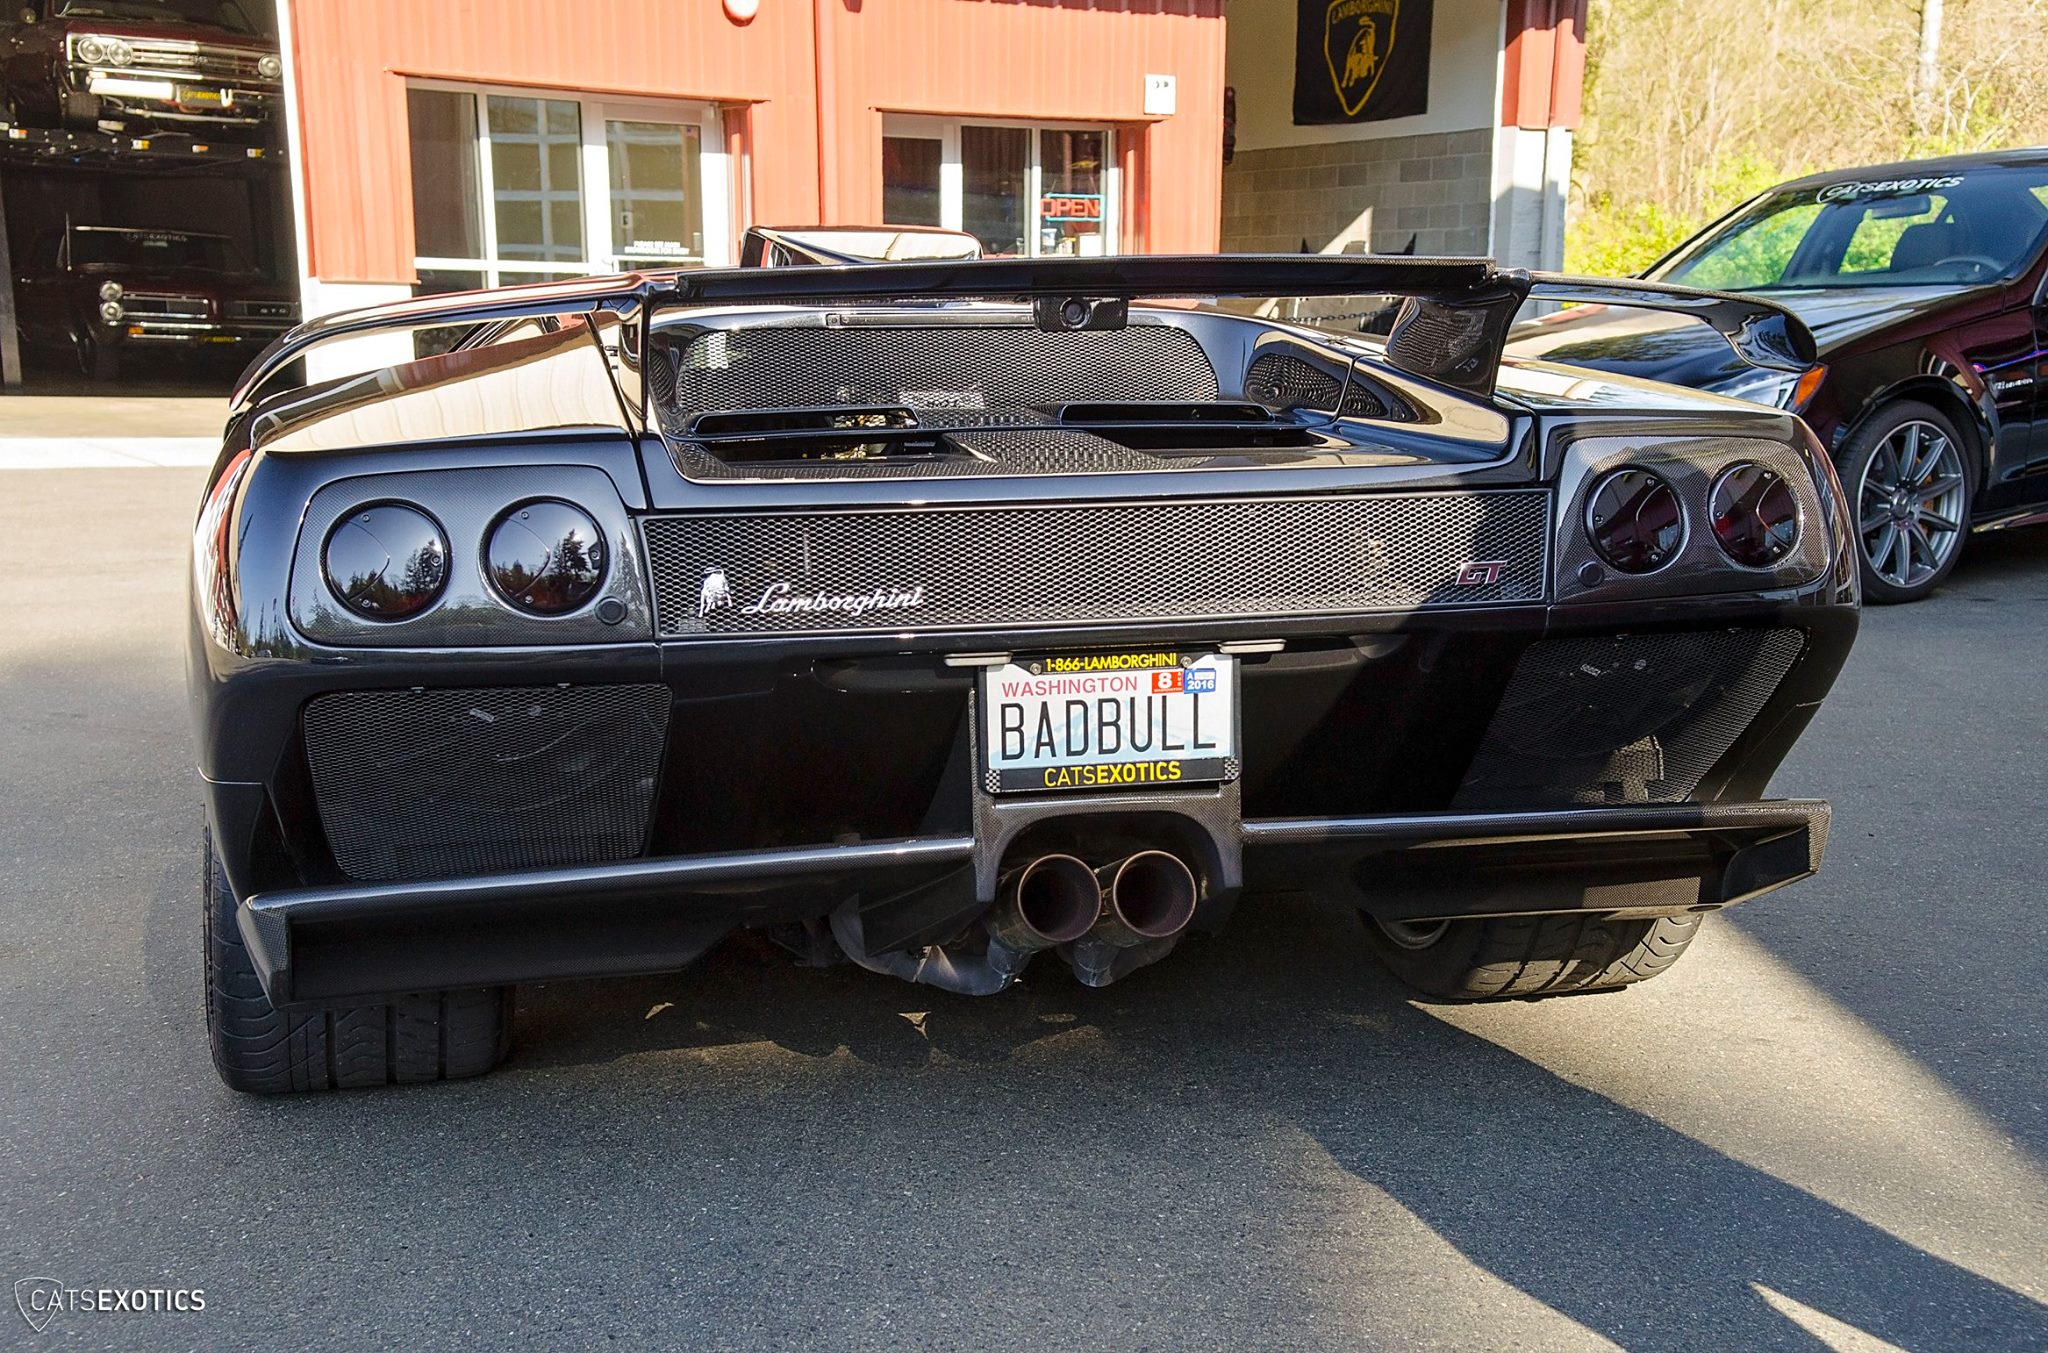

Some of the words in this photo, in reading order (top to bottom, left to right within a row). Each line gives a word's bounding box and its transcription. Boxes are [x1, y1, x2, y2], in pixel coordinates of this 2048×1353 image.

[1826, 176, 1965, 197] CATSEXOTICS
[1040, 198, 1100, 217] OPEN
[1455, 560, 1508, 585] GT
[741, 582, 925, 617] Lamborghini
[1046, 653, 1177, 672] 1-866-LAMBORGHINI
[1002, 676, 1138, 698] WASHINGTON
[1157, 672, 1173, 689] 8
[1187, 680, 1215, 690] 2016
[1001, 694, 1217, 761] BADBULL
[1044, 761, 1182, 787] CATSEXOTICS
